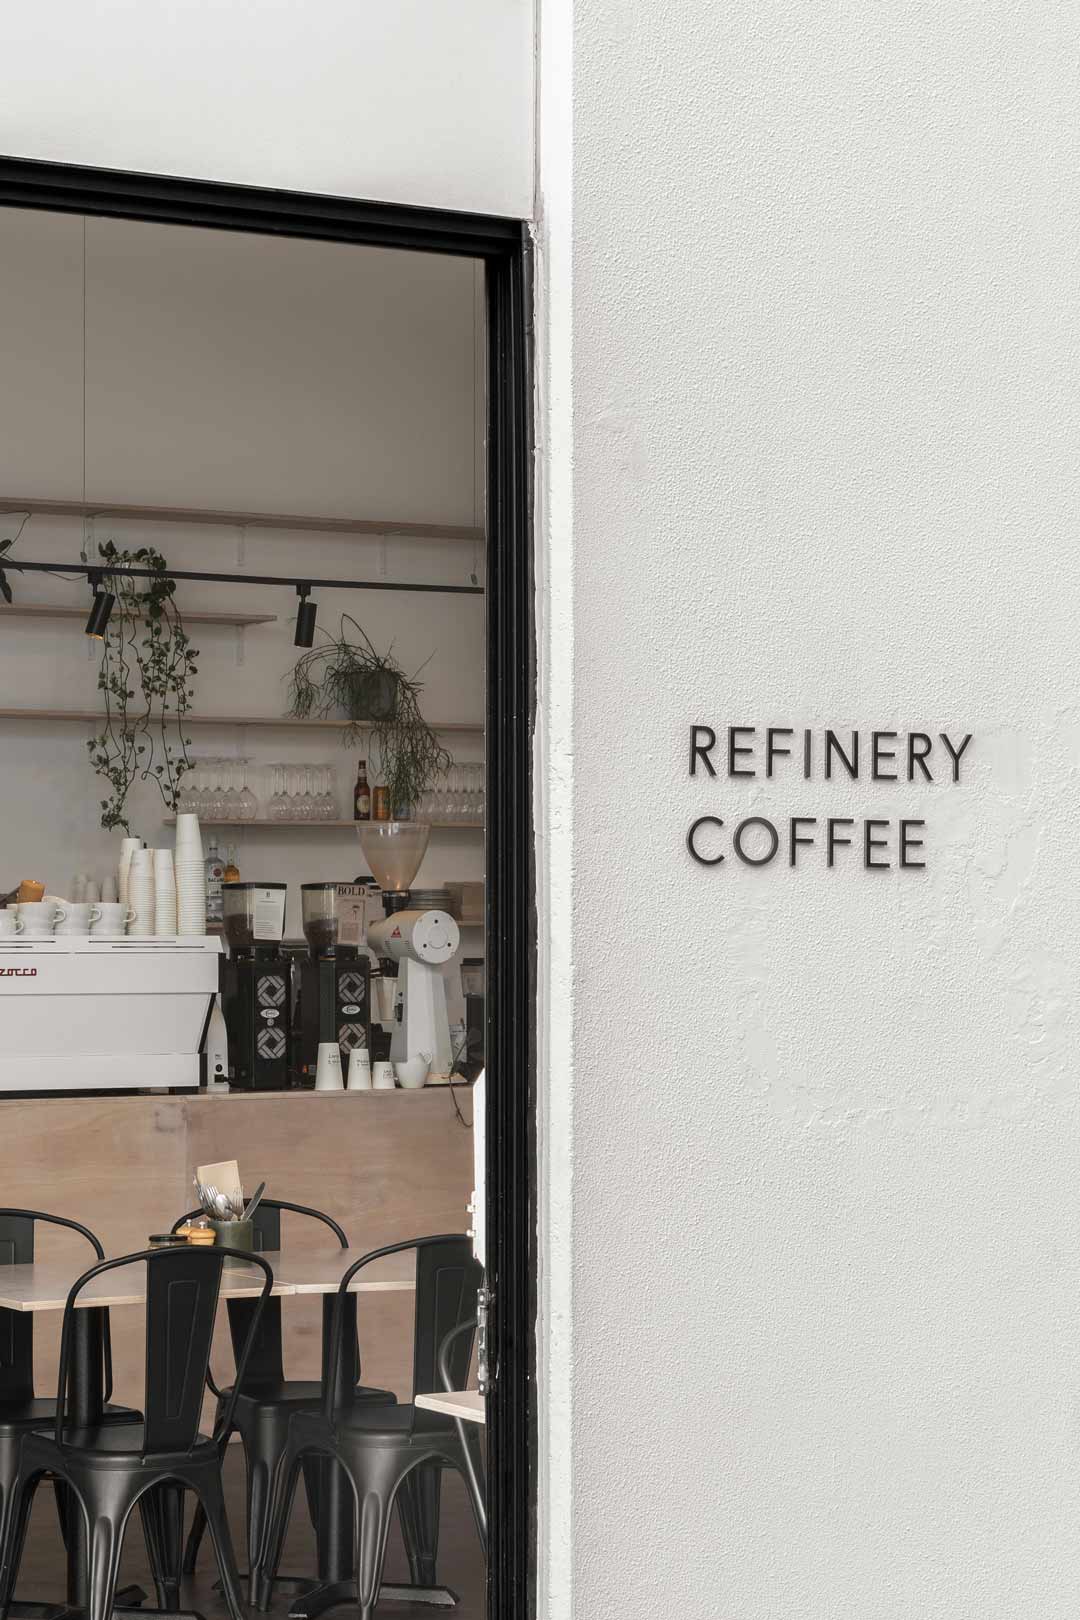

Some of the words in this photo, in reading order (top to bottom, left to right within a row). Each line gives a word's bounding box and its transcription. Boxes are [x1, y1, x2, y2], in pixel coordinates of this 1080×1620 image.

[689, 725, 973, 782] REFINERY
[686, 815, 926, 868] COFFEE
[337, 886, 365, 896] BOLD
